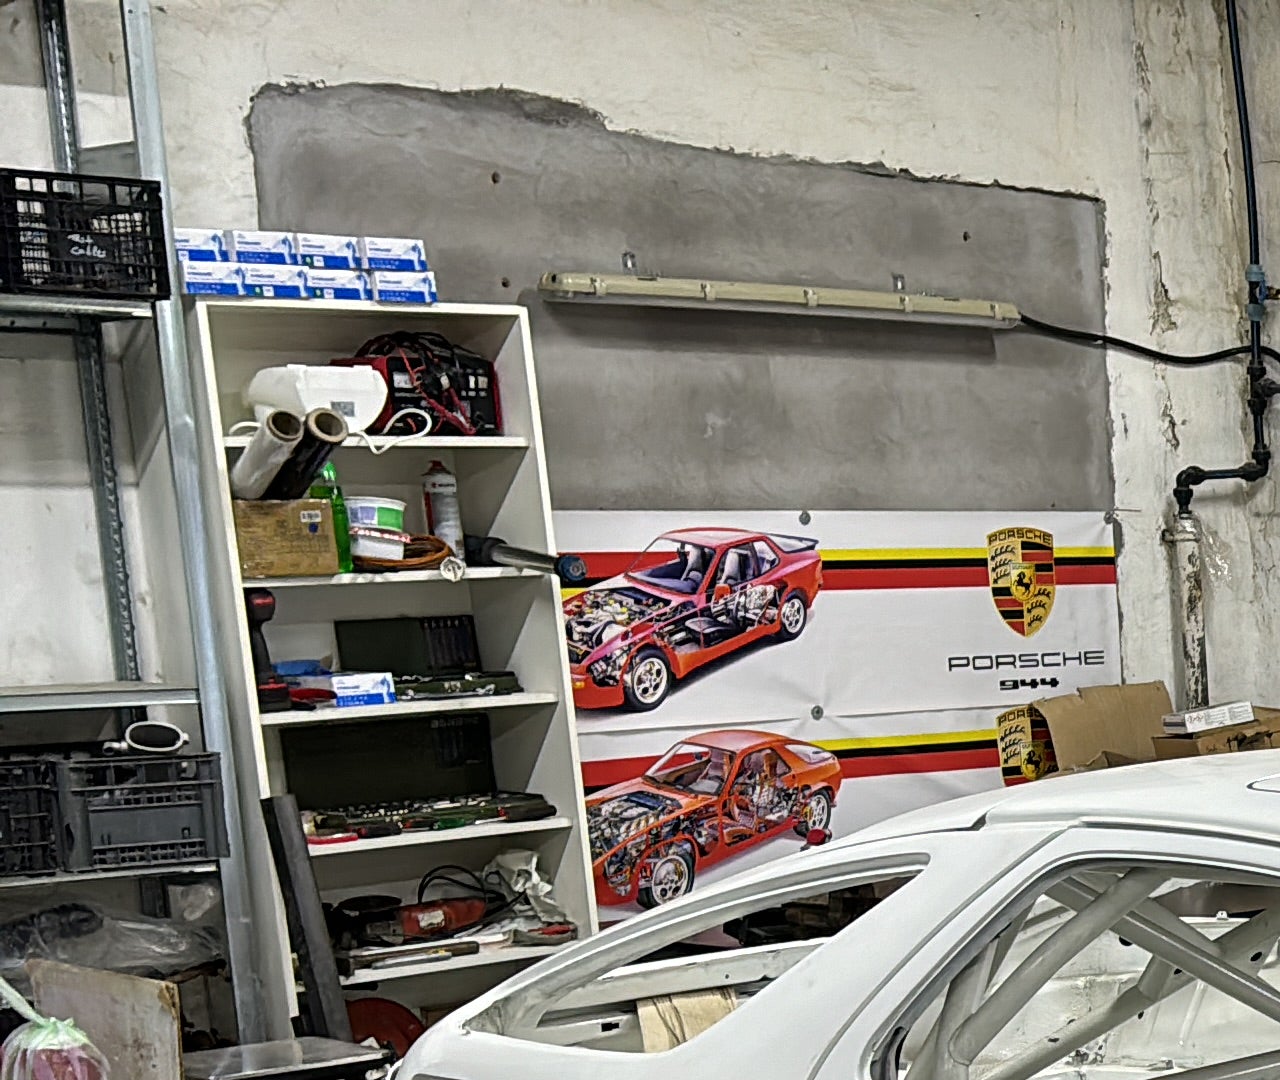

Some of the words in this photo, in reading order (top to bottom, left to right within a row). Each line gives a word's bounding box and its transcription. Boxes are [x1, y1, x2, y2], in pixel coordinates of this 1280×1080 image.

[988, 529, 1052, 546] PORSCHE
[948, 650, 1105, 672] PORSCHE
[999, 677, 1060, 691] 944
[996, 708, 1041, 727] PORSC
